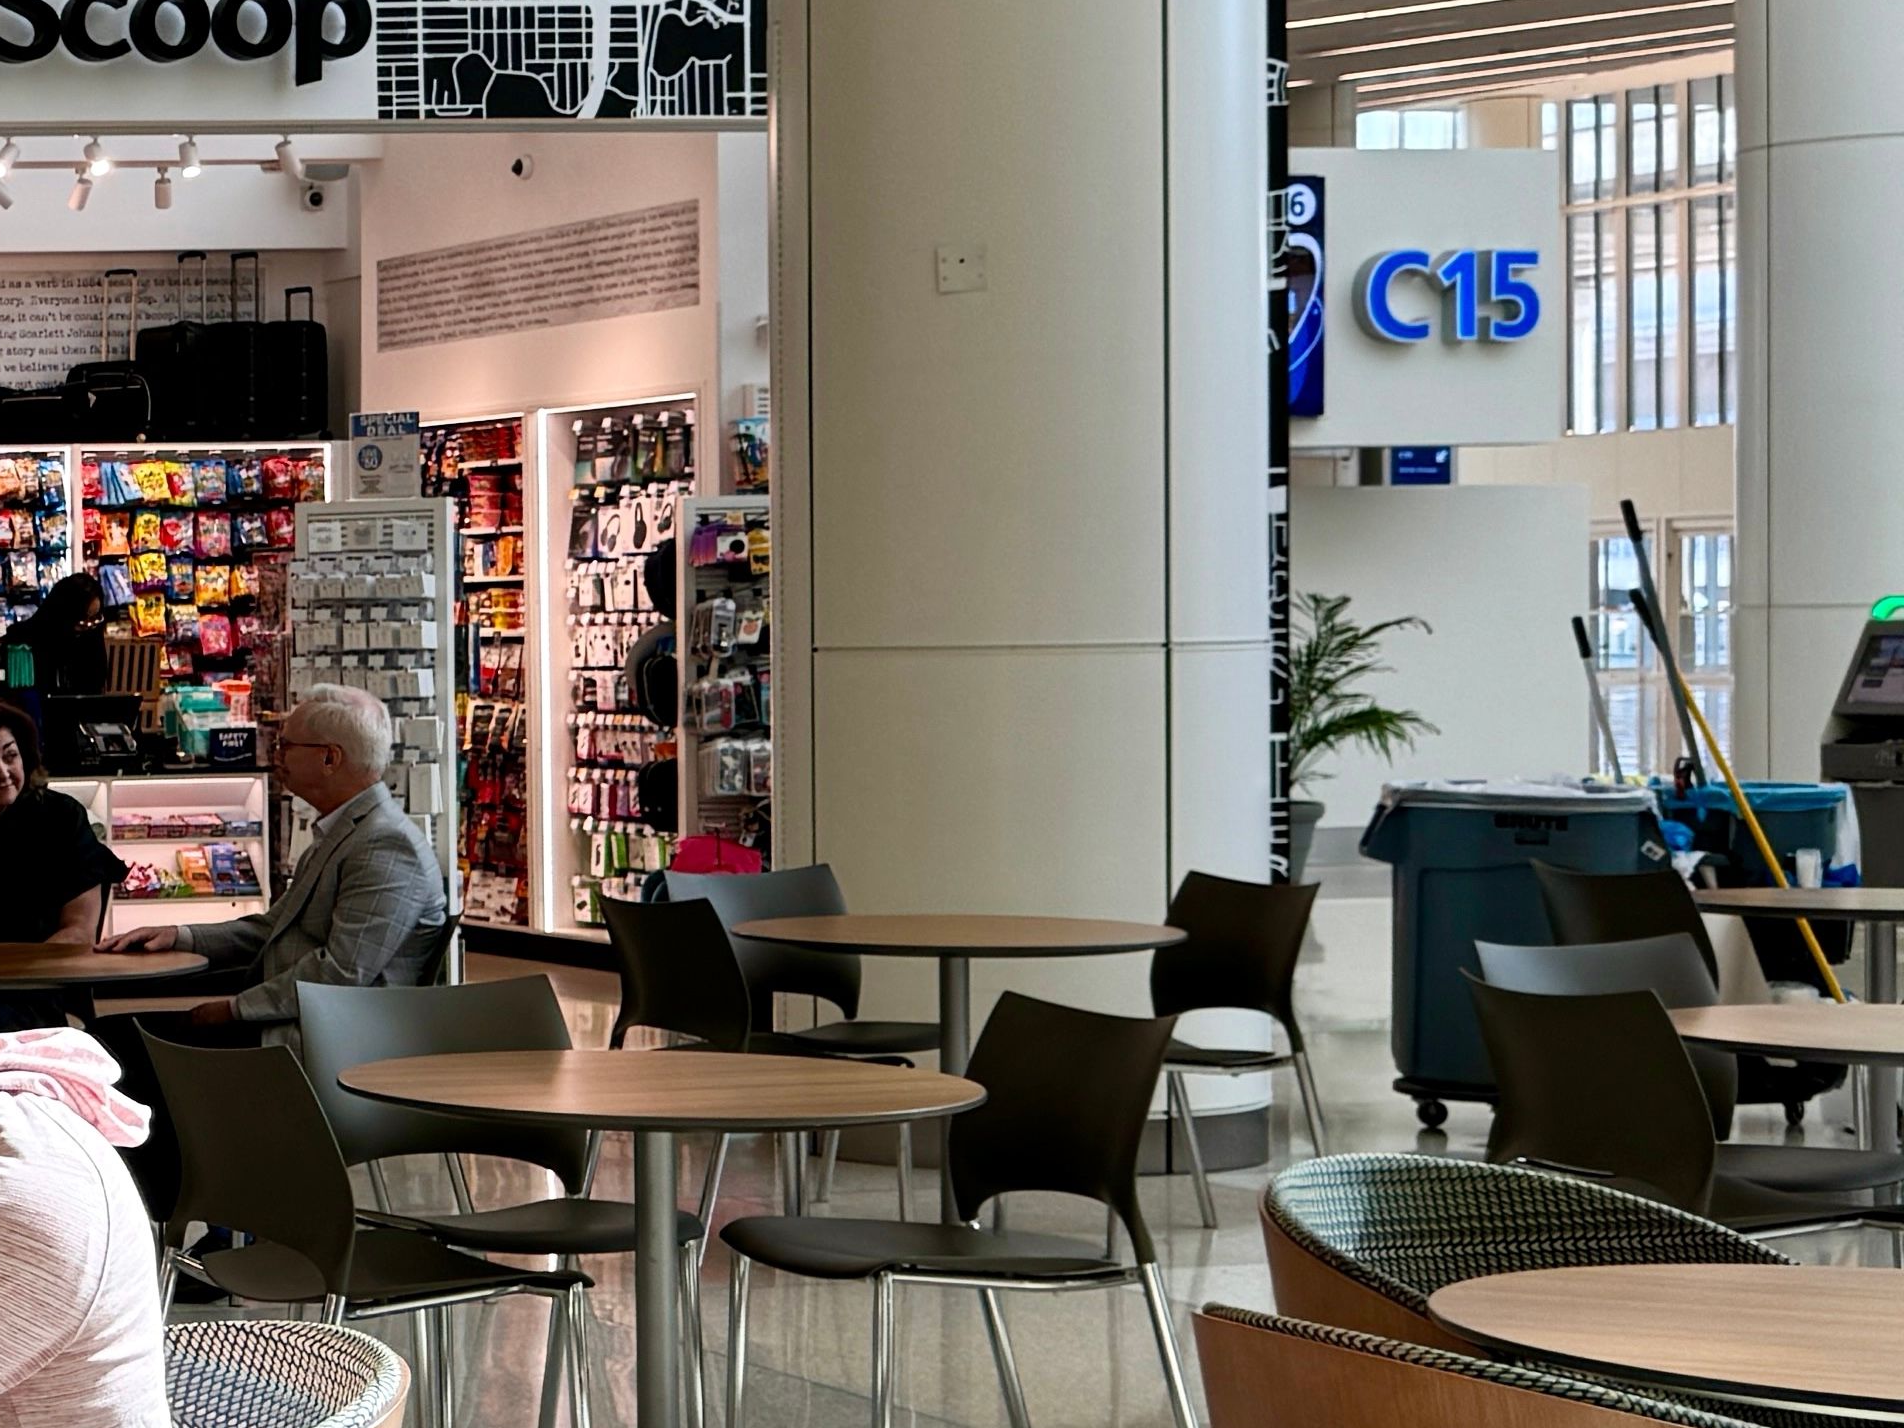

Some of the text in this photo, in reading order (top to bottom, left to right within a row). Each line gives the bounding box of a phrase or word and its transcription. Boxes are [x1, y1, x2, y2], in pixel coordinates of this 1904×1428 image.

[9, 280, 22, 289] as
[25, 280, 32, 289] a
[35, 278, 59, 289] verb
[61, 278, 74, 288] in
[30, 294, 80, 307] Everyone
[1352, 248, 1541, 343] C15
[18, 312, 26, 322] it
[29, 311, 57, 322] can't
[59, 311, 72, 321] be
[74, 311, 132, 322] consiered
[19, 328, 65, 339] Scarlett
[6, 346, 36, 358] story
[38, 347, 59, 356] and
[62, 345, 87, 355] then
[4, 364, 17, 372] we
[19, 362, 59, 372] believe
[359, 413, 414, 426] SPECIAL
[366, 425, 407, 437] DEAL
